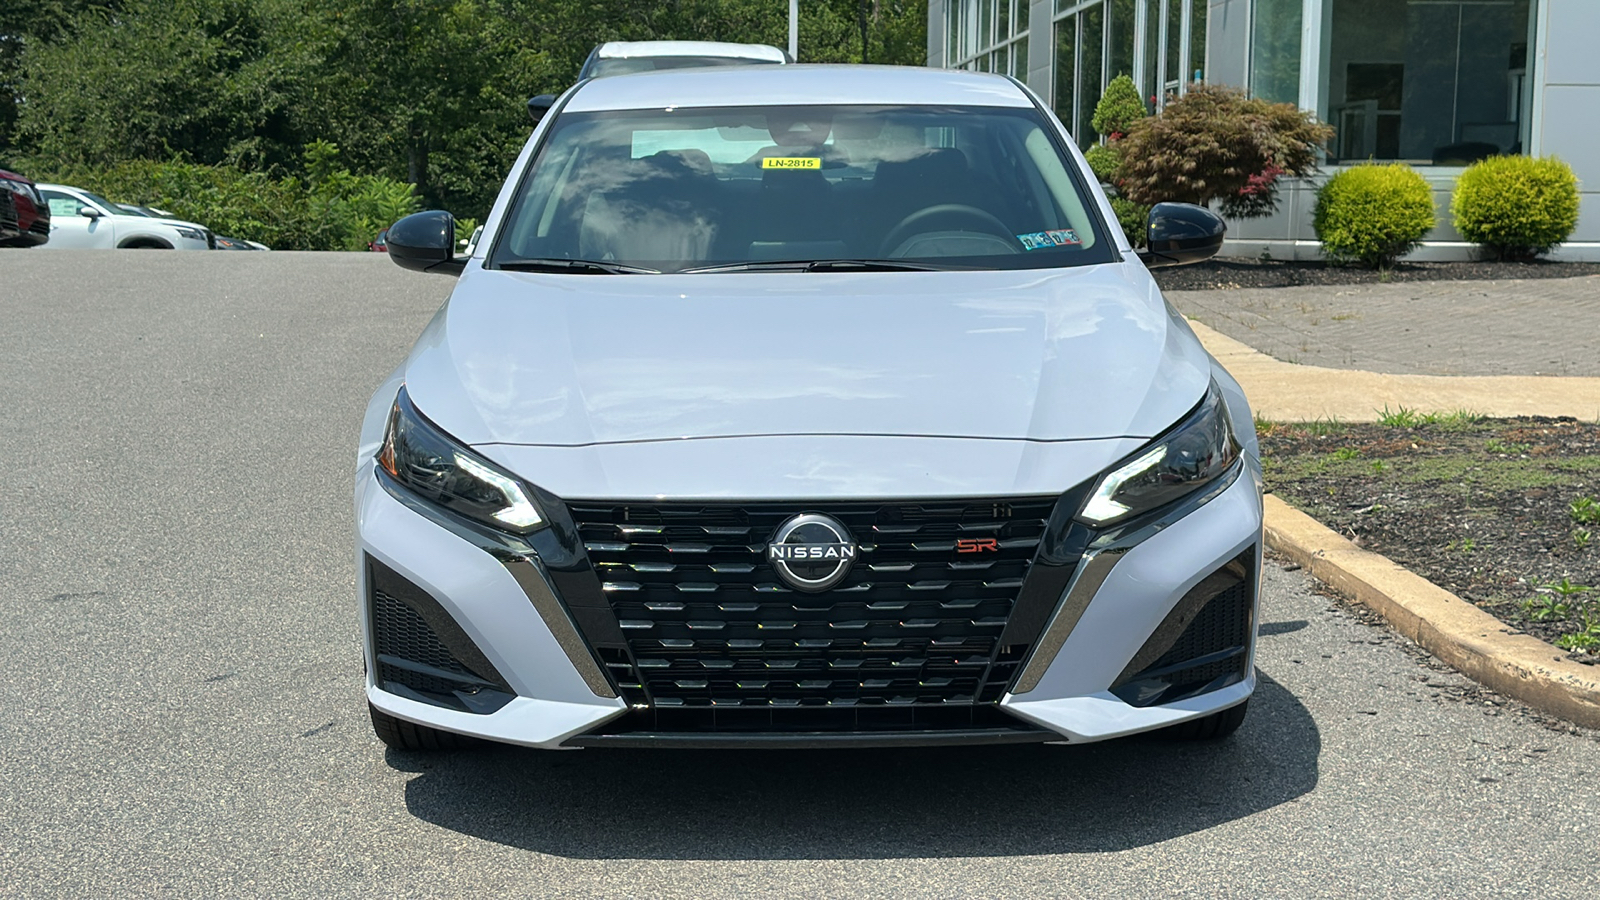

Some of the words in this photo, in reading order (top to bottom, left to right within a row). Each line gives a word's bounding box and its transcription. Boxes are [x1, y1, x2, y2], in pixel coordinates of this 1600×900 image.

[768, 159, 814, 168] LN-2815
[957, 538, 998, 553] SR
[771, 546, 854, 558] NISSAN
